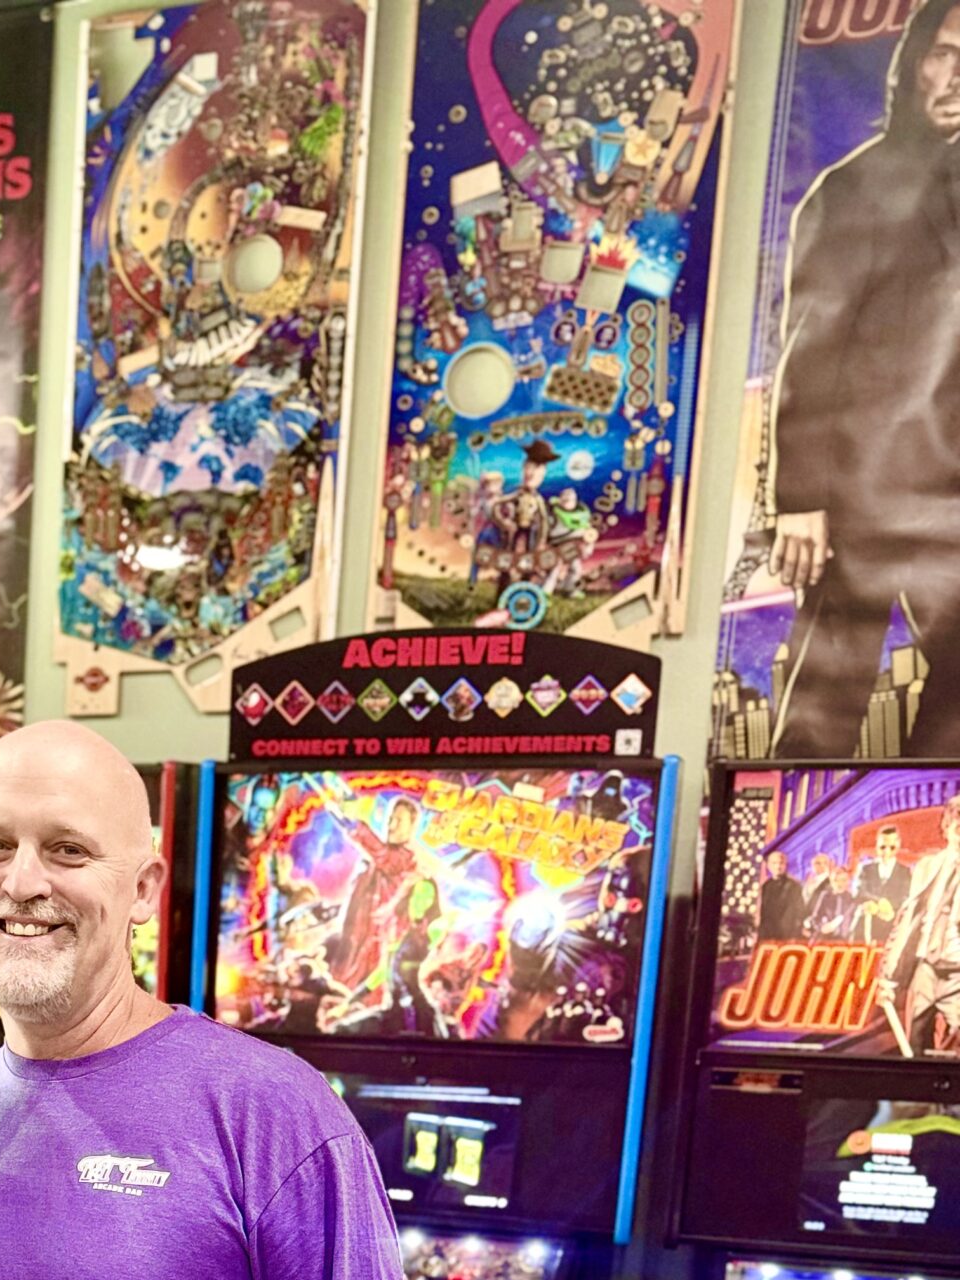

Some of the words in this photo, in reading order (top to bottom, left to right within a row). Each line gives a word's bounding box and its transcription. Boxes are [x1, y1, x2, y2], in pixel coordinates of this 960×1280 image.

[342, 632, 525, 668] ACHIEVE!
[252, 738, 348, 757] CONNECT
[354, 738, 381, 755] TO
[385, 737, 431, 755] WIN
[438, 734, 611, 755] ACHIEVEMENTS
[421, 779, 630, 851] GUARDIANS
[456, 811, 618, 876] GALAXY
[719, 943, 883, 1030] JOHN
